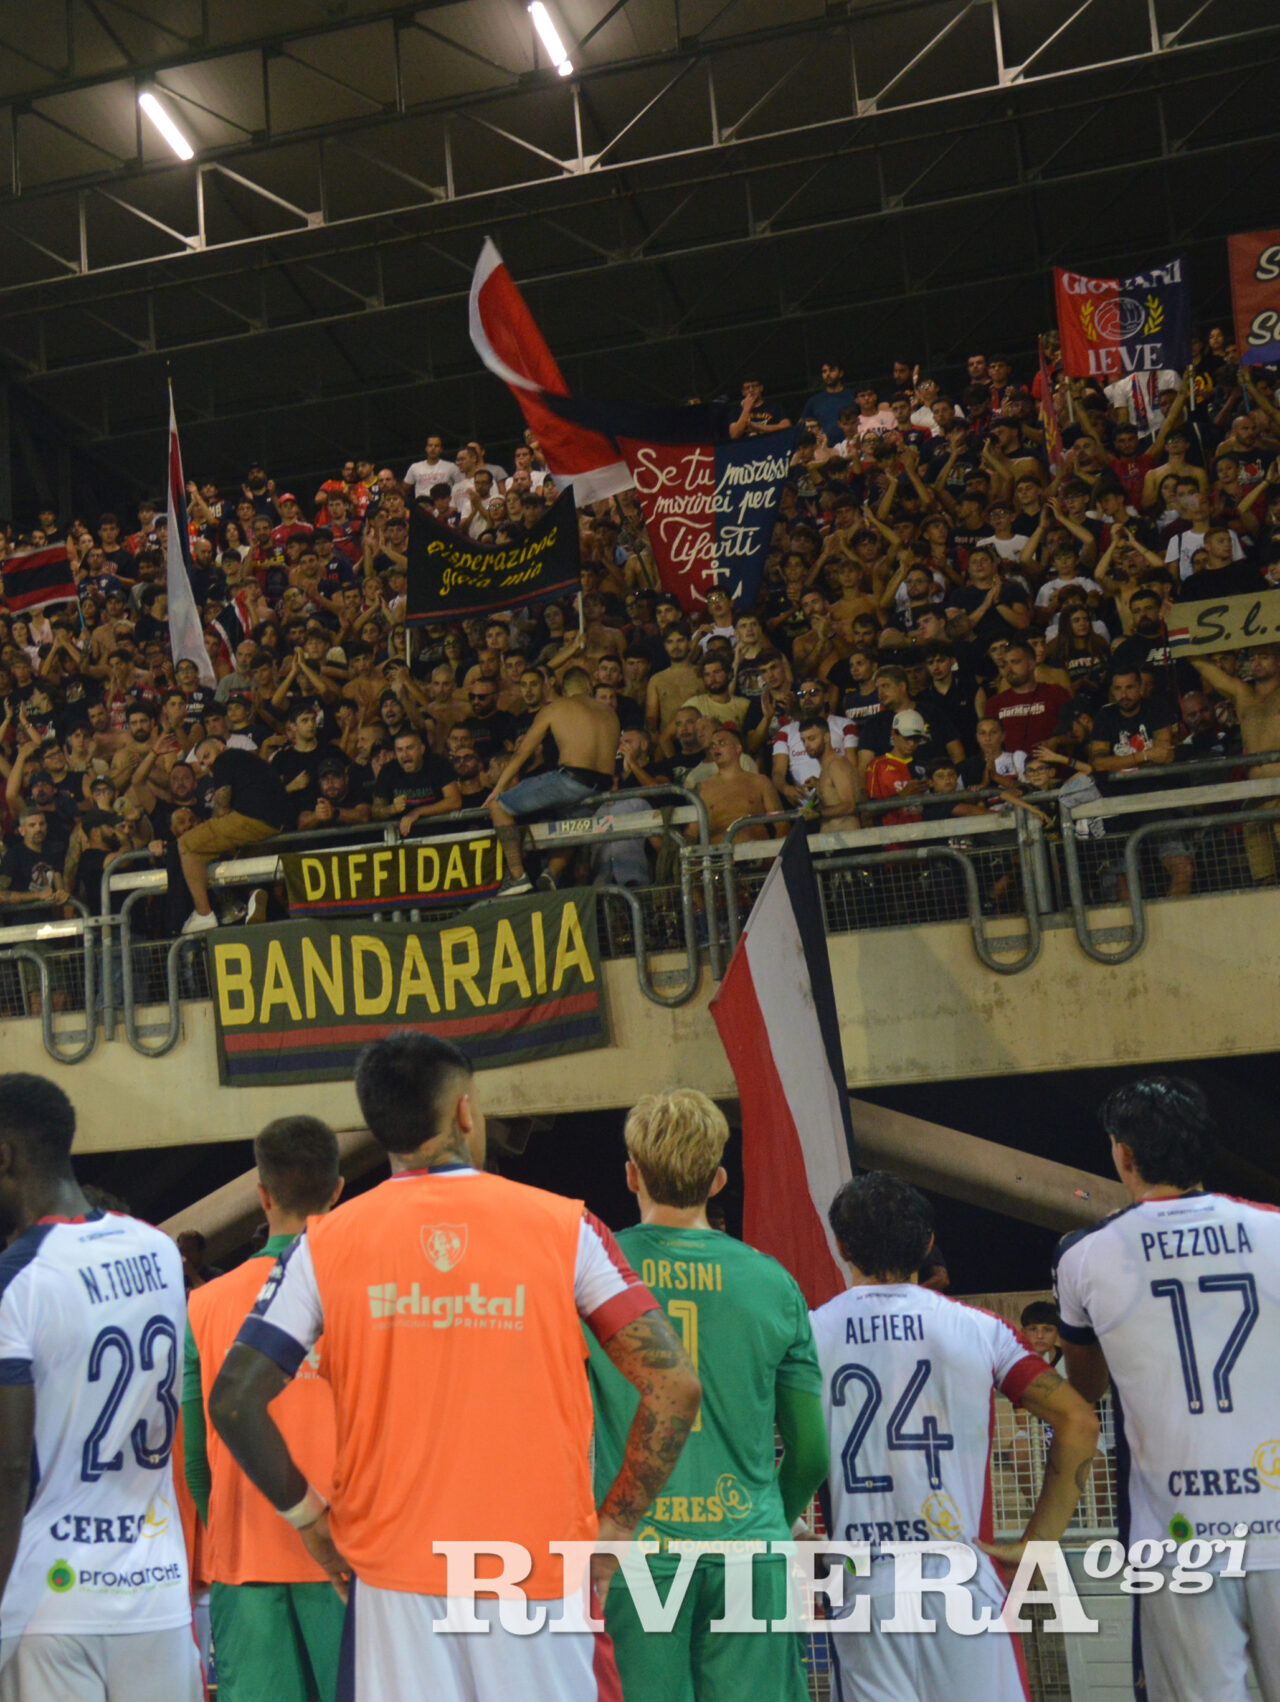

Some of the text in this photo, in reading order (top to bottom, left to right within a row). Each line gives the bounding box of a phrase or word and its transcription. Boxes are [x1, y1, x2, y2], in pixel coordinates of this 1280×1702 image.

[1088, 343, 1163, 375] LEVE
[633, 448, 681, 494] Se
[681, 448, 715, 490] tu
[738, 487, 776, 524] per
[301, 839, 503, 901] DIFFIDATI
[214, 901, 594, 1026] BANDARAIA
[1141, 1222, 1253, 1262] PEZZOLA
[78, 1252, 168, 1304] N.TOURE
[642, 1258, 723, 1291] ORSINI
[397, 1282, 525, 1329] digital
[455, 1318, 524, 1331] PRINTING
[846, 1314, 924, 1344] ALFIERI
[1150, 1273, 1260, 1414] 17
[80, 1314, 182, 1483] 23
[831, 1359, 953, 1494] 24
[1168, 1467, 1261, 1497] CERES
[644, 1496, 724, 1522] ERES
[845, 1519, 930, 1547] CERES
